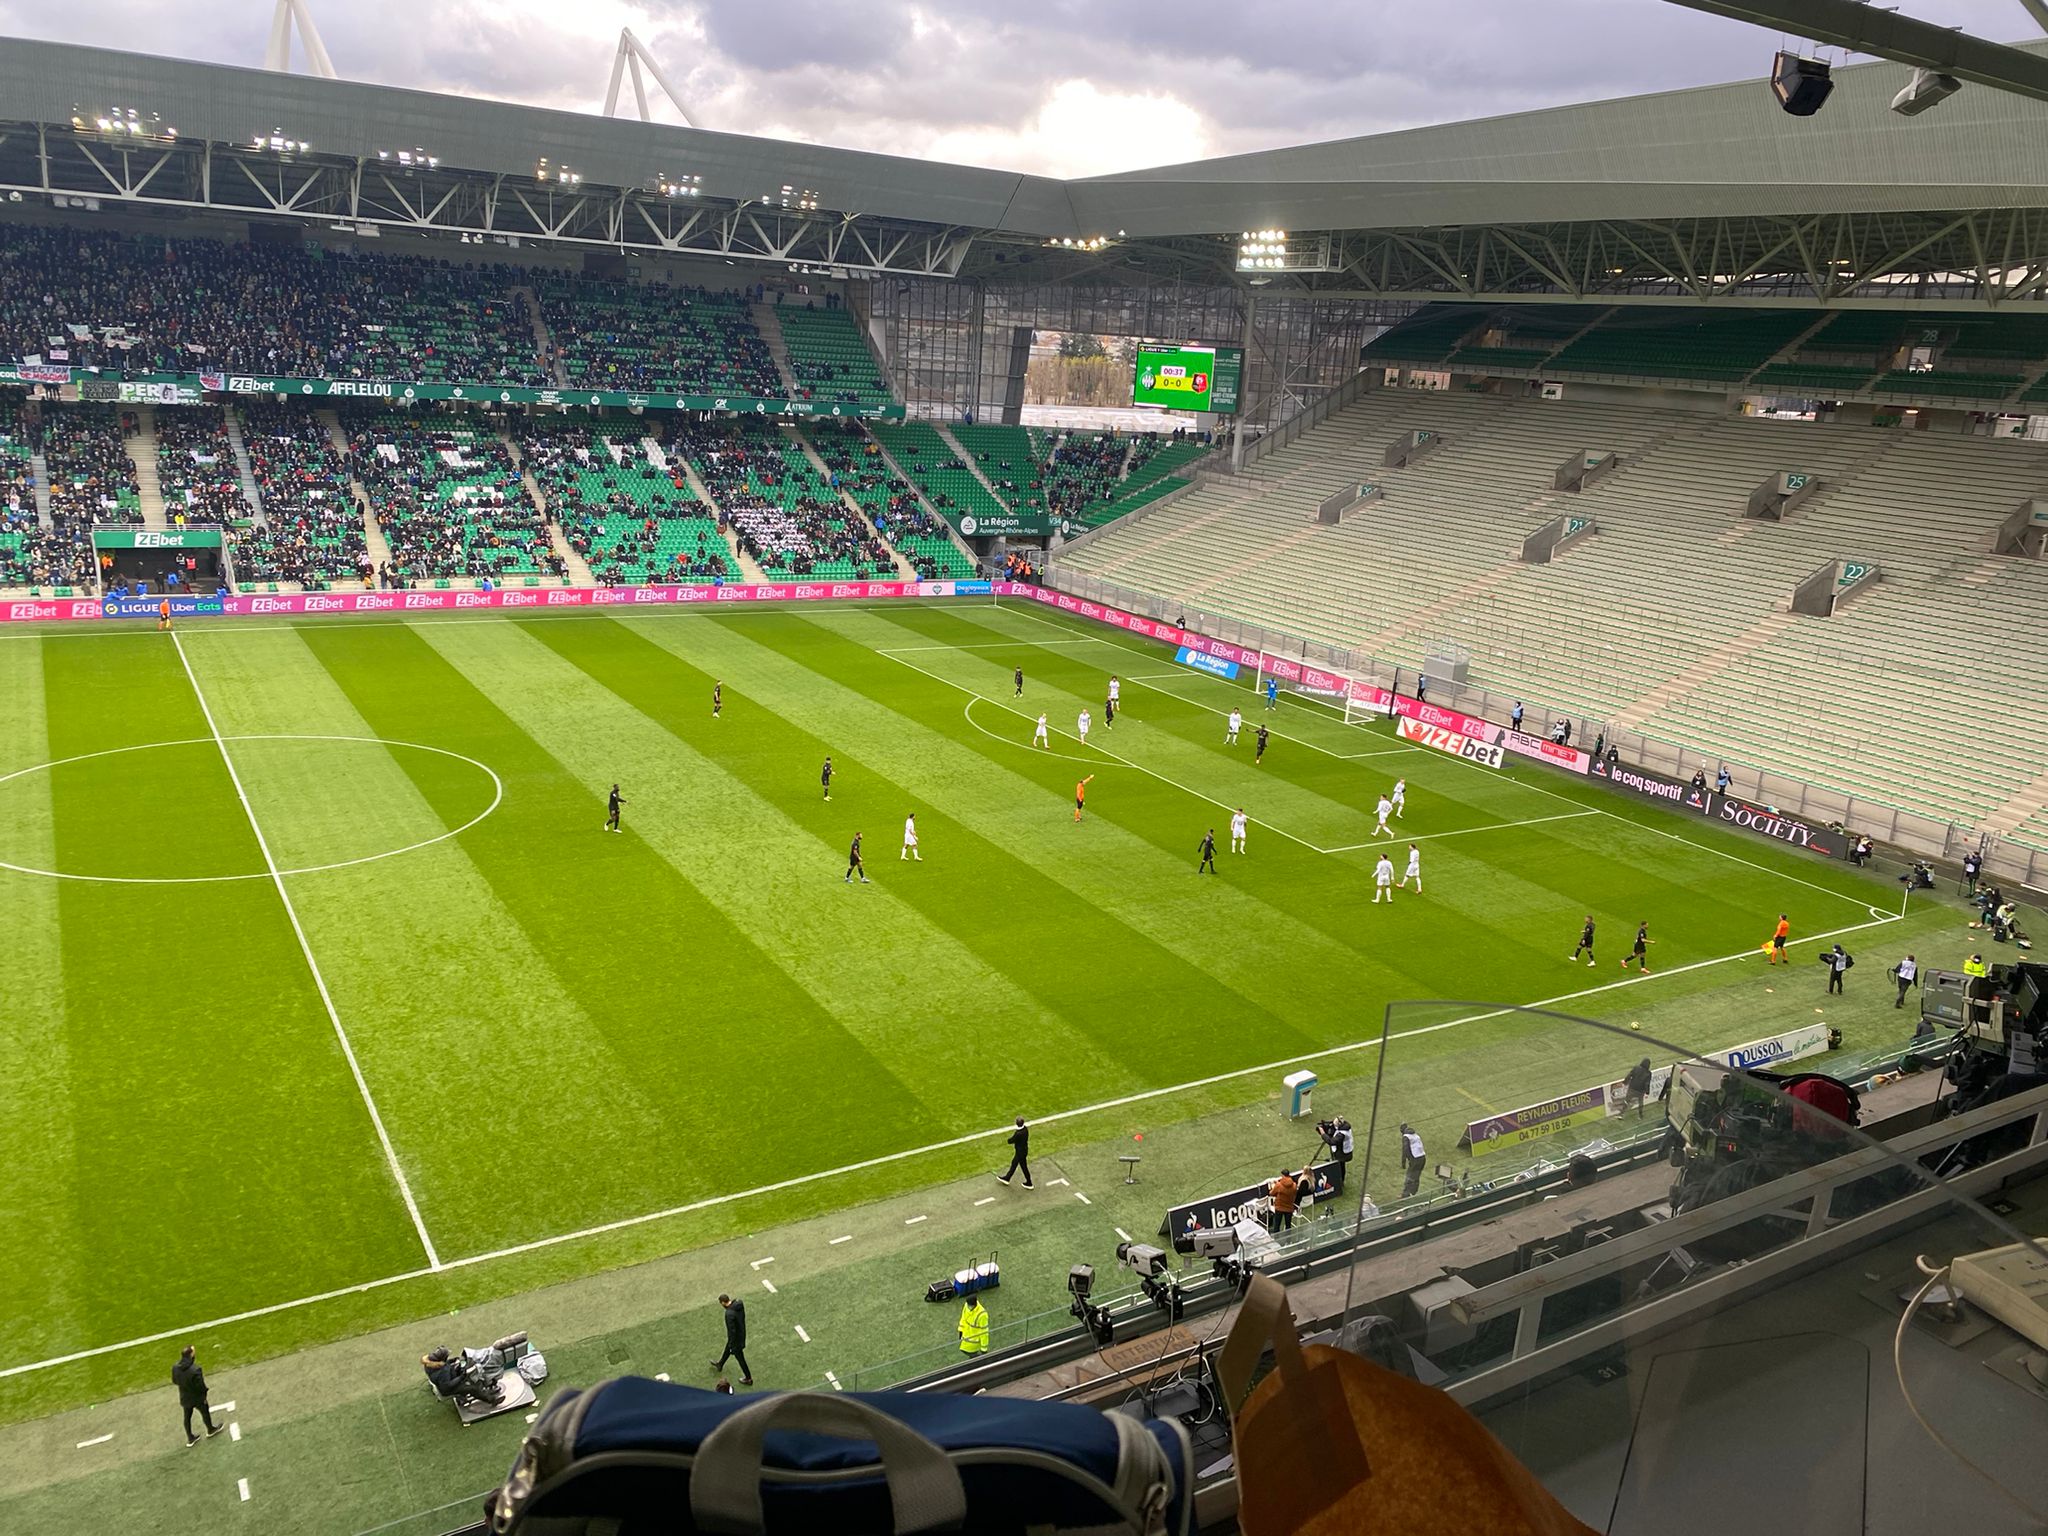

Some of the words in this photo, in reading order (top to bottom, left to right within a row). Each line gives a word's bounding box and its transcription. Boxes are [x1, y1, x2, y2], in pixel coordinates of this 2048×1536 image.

[1163, 368, 1184, 376] 00:37
[229, 377, 275, 391] ZEbet
[327, 382, 392, 397] AFFLELOU
[1788, 476, 1805, 489] 25
[979, 517, 990, 526] La
[990, 517, 1020, 527] Région
[135, 533, 184, 547] ZEbet
[548, 590, 582, 604] ZEbet
[592, 590, 625, 603] ZEbet
[635, 589, 667, 602] ZEbet
[677, 588, 708, 601] ZEbet
[718, 585, 748, 599] ZEbet
[757, 585, 786, 598] ZEbet
[796, 585, 825, 597] ZEbet
[252, 598, 292, 612] ZEbet
[305, 597, 344, 611] ZEbet
[356, 595, 394, 609] ZEbet
[406, 594, 444, 609] ZEbet
[456, 593, 491, 607] ZEbet
[503, 592, 537, 605] ZEbet
[11, 604, 57, 619] ZEbet
[121, 605, 160, 613] LIGUE
[172, 604, 196, 612] Uber
[197, 603, 221, 611] Eats
[1306, 671, 1334, 690] ZEbet
[1380, 692, 1411, 712] Zbet
[1419, 705, 1453, 727] ZEbet
[1429, 728, 1500, 766] ZEbet
[1511, 732, 1540, 750] ABC
[1611, 765, 1622, 782] le
[1623, 770, 1643, 791] coq
[1644, 778, 1683, 801] sportif
[1720, 800, 1816, 846] SOCIETY
[1517, 1101, 1559, 1124] REYNAUD
[1561, 1093, 1592, 1112] FLEURS
[1519, 1131, 1529, 1141] 04
[1529, 1128, 1539, 1139] 77
[1540, 1125, 1550, 1136] 59
[1551, 1123, 1560, 1133] 18
[1561, 1118, 1571, 1129] 50
[1211, 1208, 1227, 1228] le
[1111, 1329, 1186, 1362] ATTENTION
